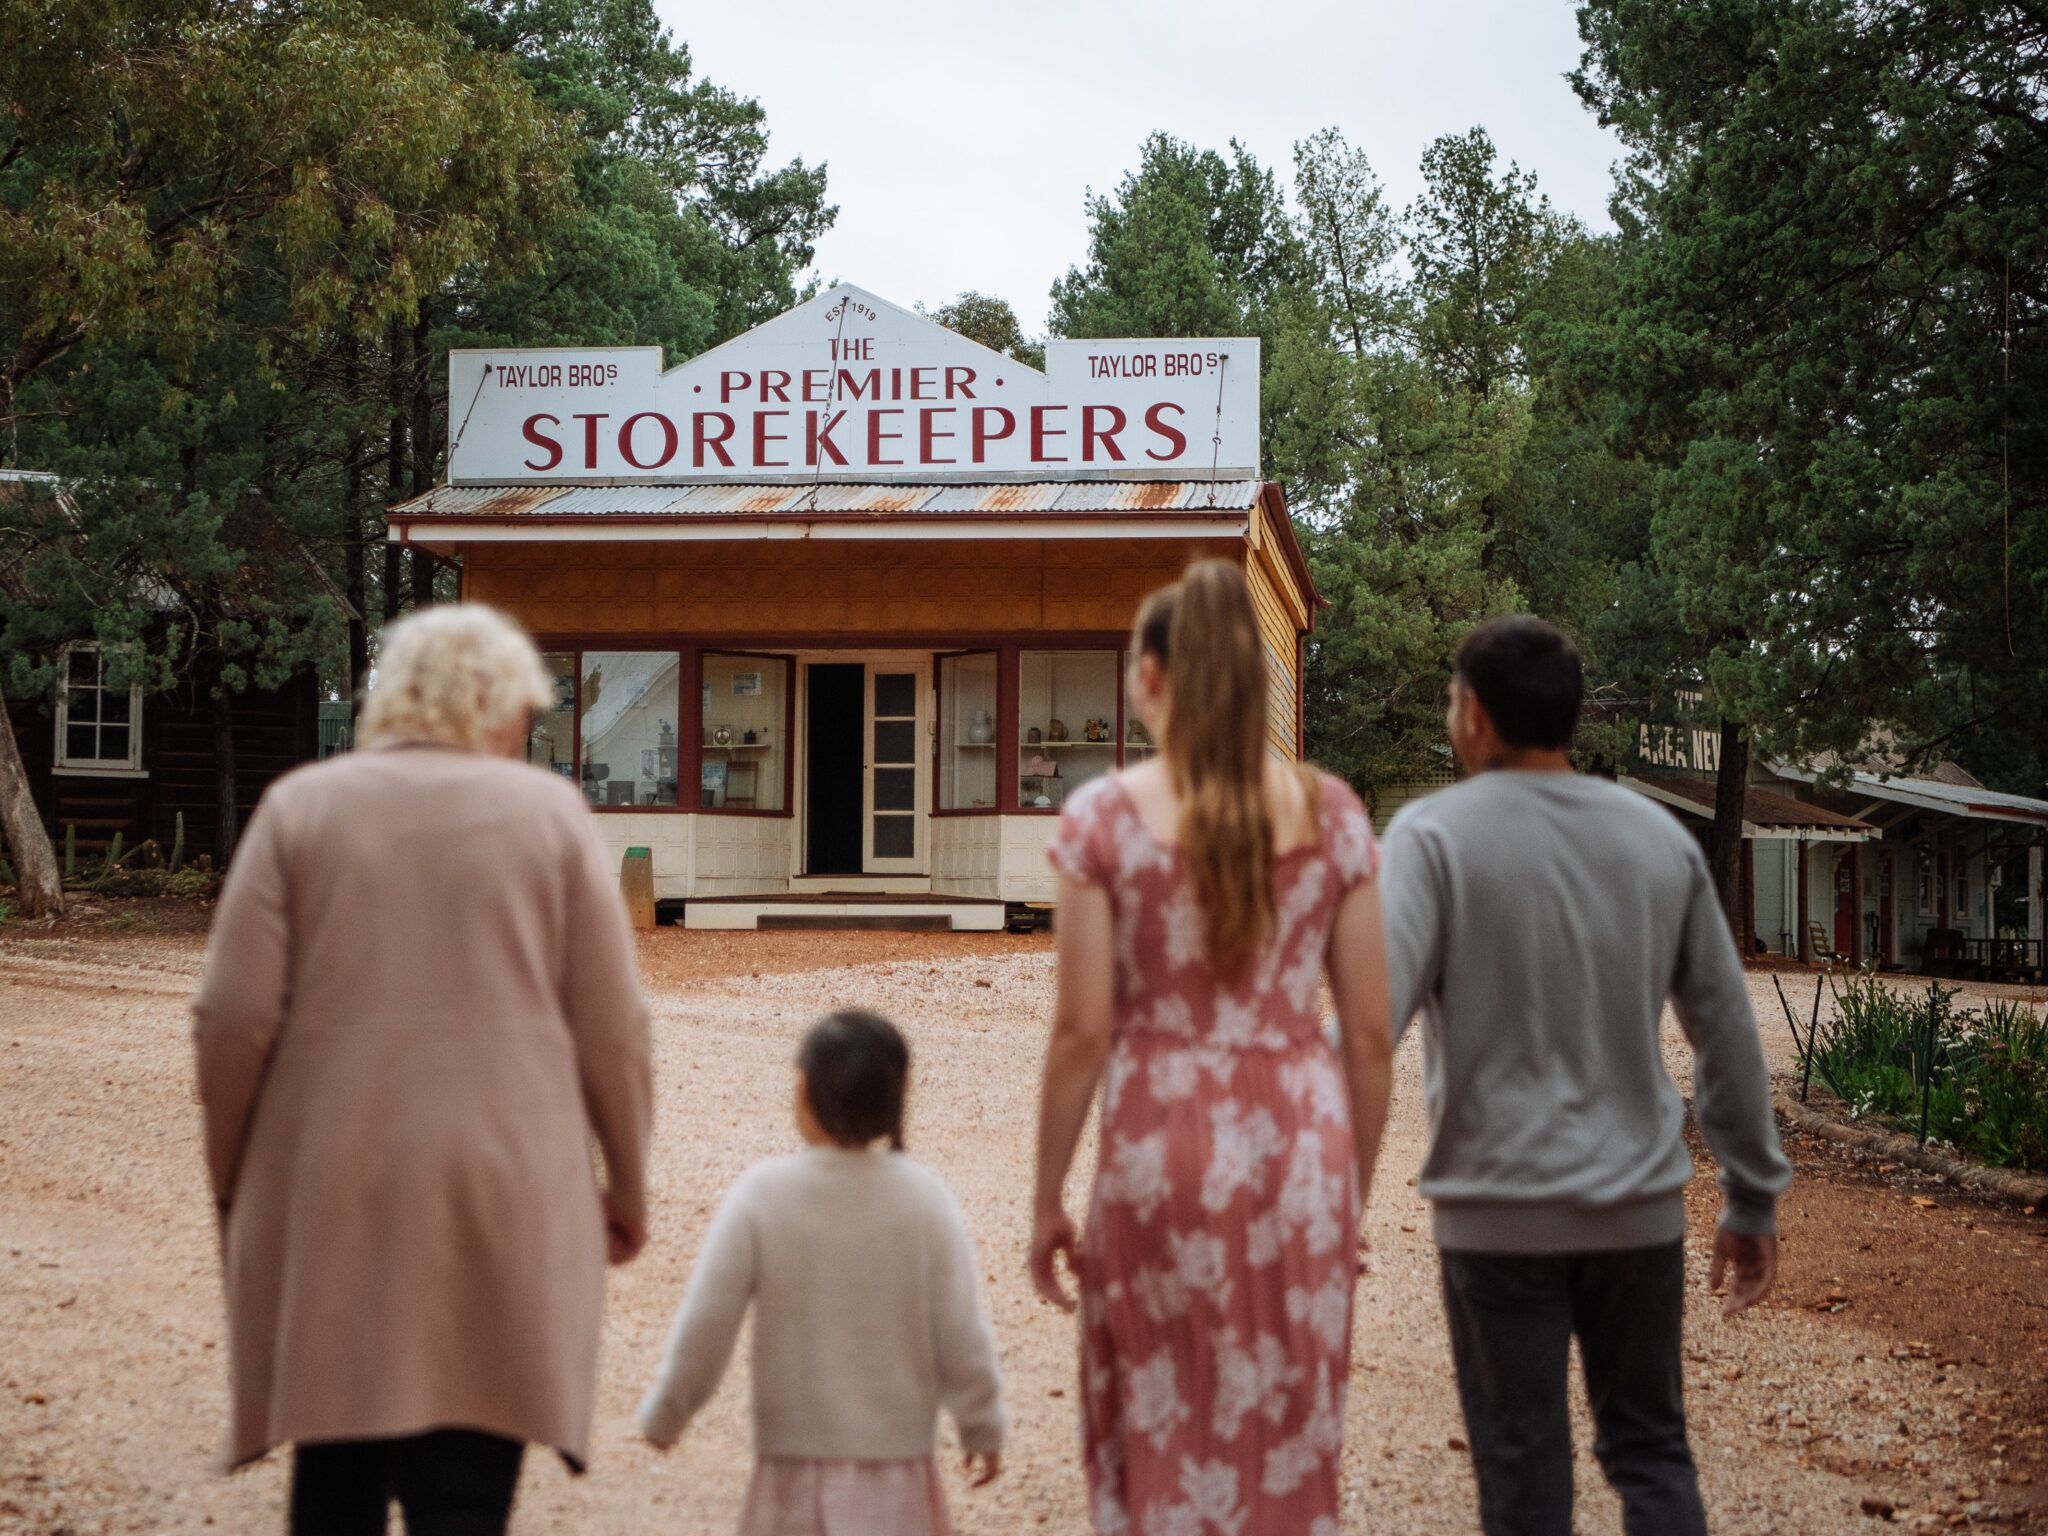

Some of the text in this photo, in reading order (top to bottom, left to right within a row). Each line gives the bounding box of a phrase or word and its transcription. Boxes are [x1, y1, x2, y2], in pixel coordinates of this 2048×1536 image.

[852, 302, 876, 321] 1919
[827, 338, 875, 361] THE
[496, 365, 562, 388] TAYLOR
[1088, 354, 1157, 378] TAYLOR
[720, 366, 977, 404] PREMIER
[522, 401, 1187, 472] STOREKEEPERS
